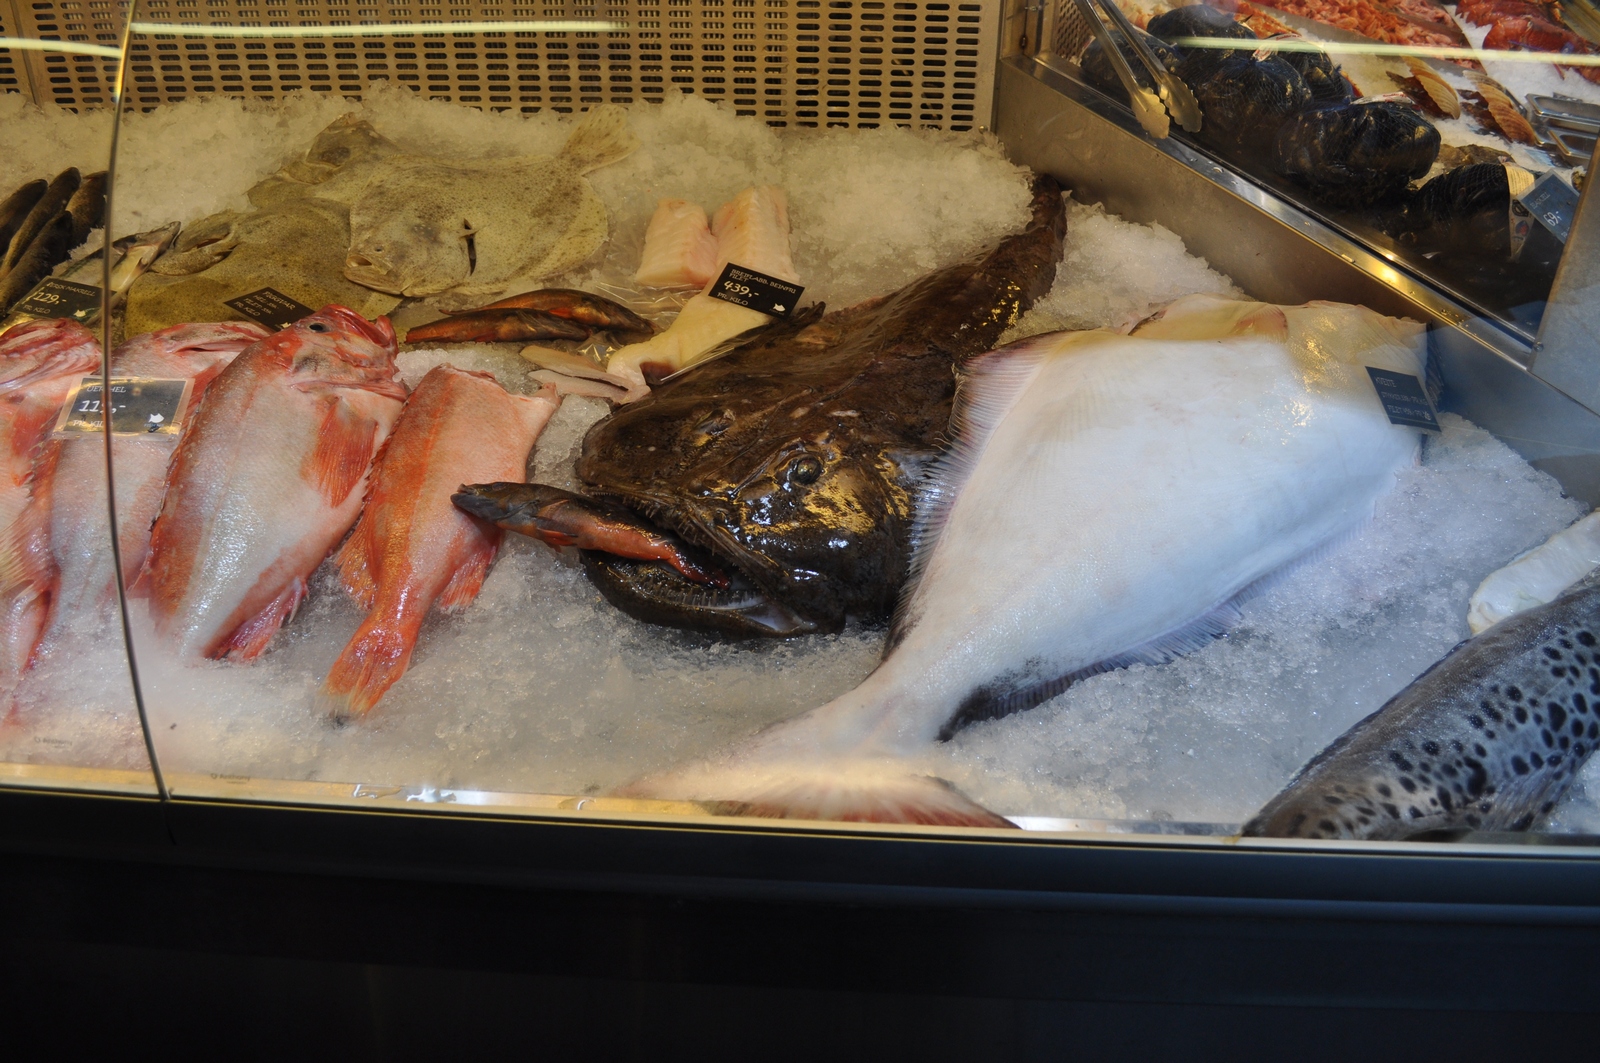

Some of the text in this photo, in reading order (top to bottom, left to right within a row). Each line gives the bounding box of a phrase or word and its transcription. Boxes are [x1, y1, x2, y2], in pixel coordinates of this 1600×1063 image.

[728, 273, 750, 283] FILET
[65, 286, 95, 296] MAKRELL
[723, 280, 760, 298] 439,-
[770, 282, 796, 294] BEINFRI
[33, 291, 67, 305] 129,-
[729, 295, 749, 306] KILO
[34, 307, 51, 315] KILO
[244, 307, 261, 317] KILO
